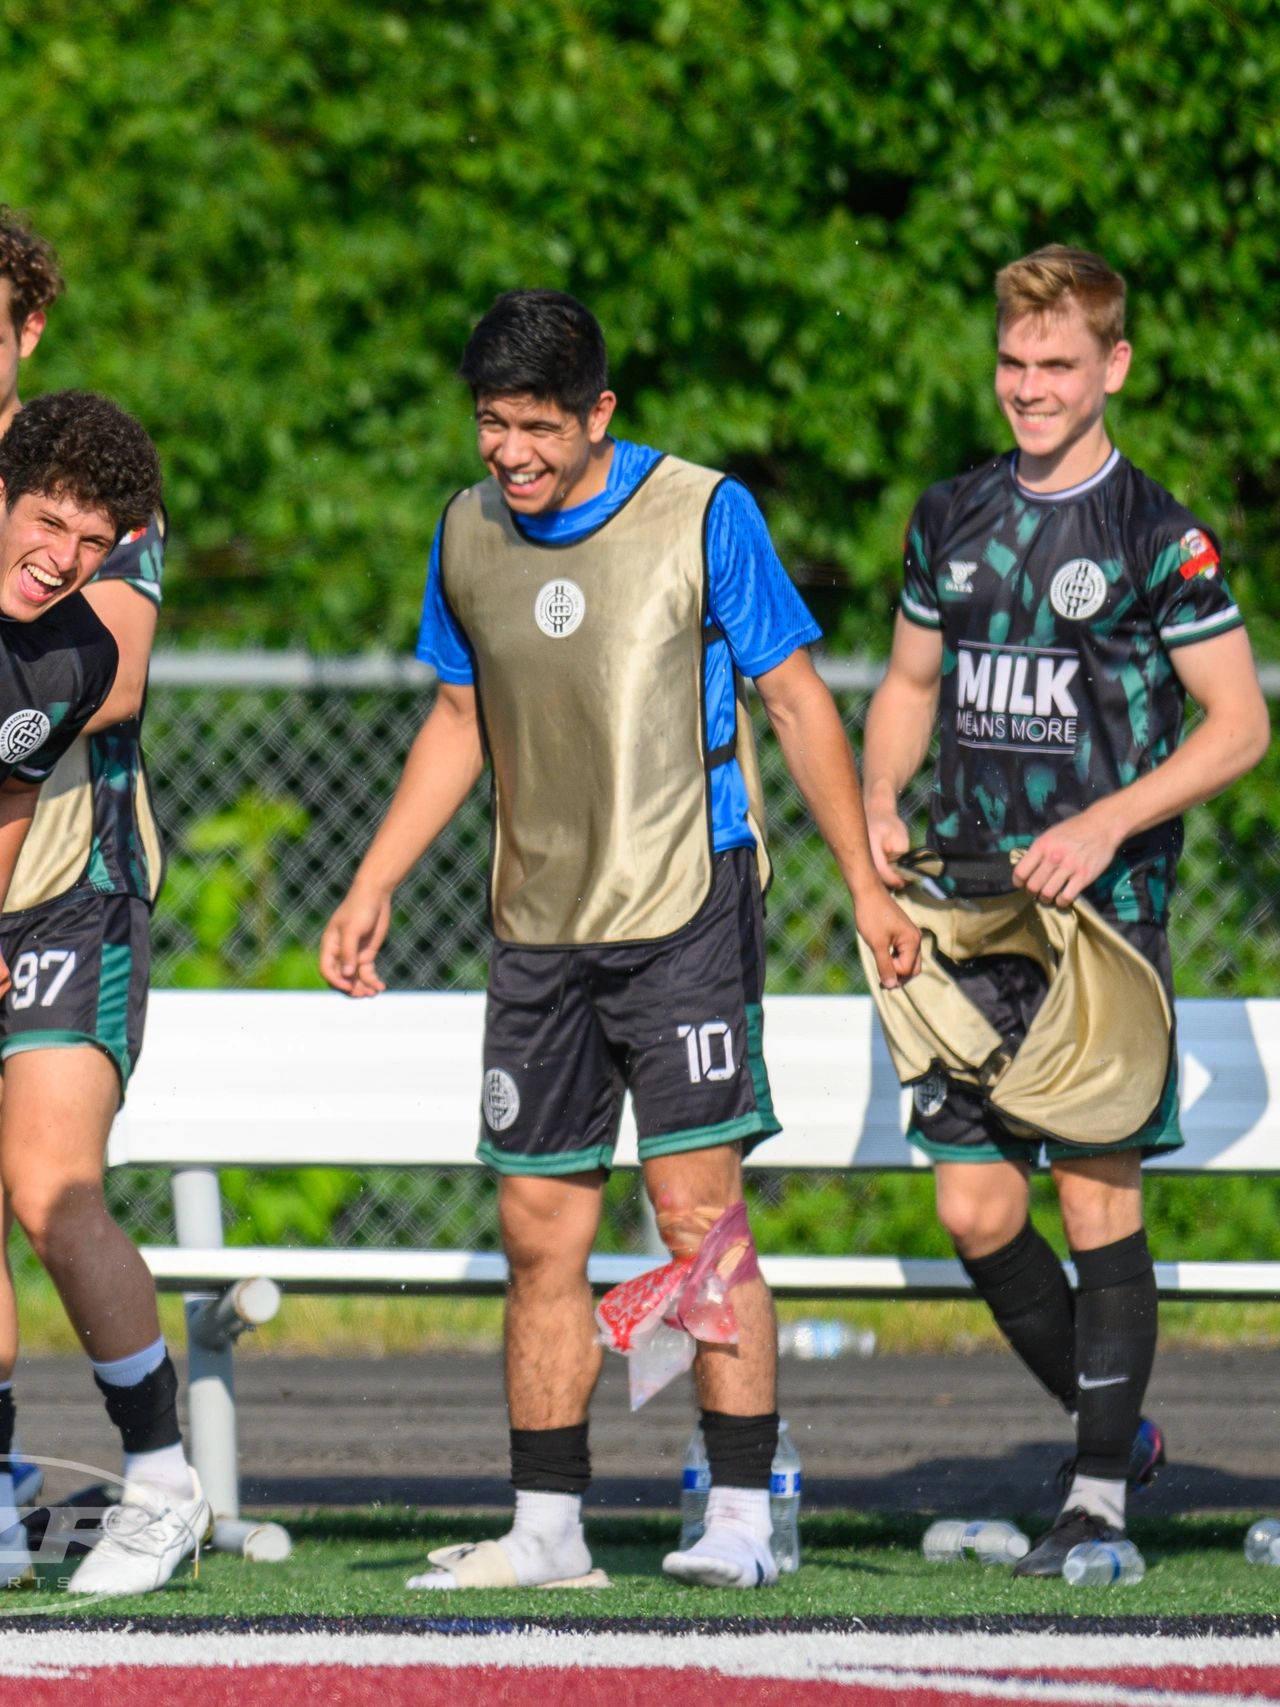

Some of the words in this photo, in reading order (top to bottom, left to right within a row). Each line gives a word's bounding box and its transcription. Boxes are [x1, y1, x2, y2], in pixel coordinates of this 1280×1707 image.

[957, 650, 1080, 717] MILK
[957, 711, 1006, 740] MEANS
[1011, 716, 1077, 744] MORE
[12, 950, 78, 1010] 97
[676, 1020, 736, 1083] 10
